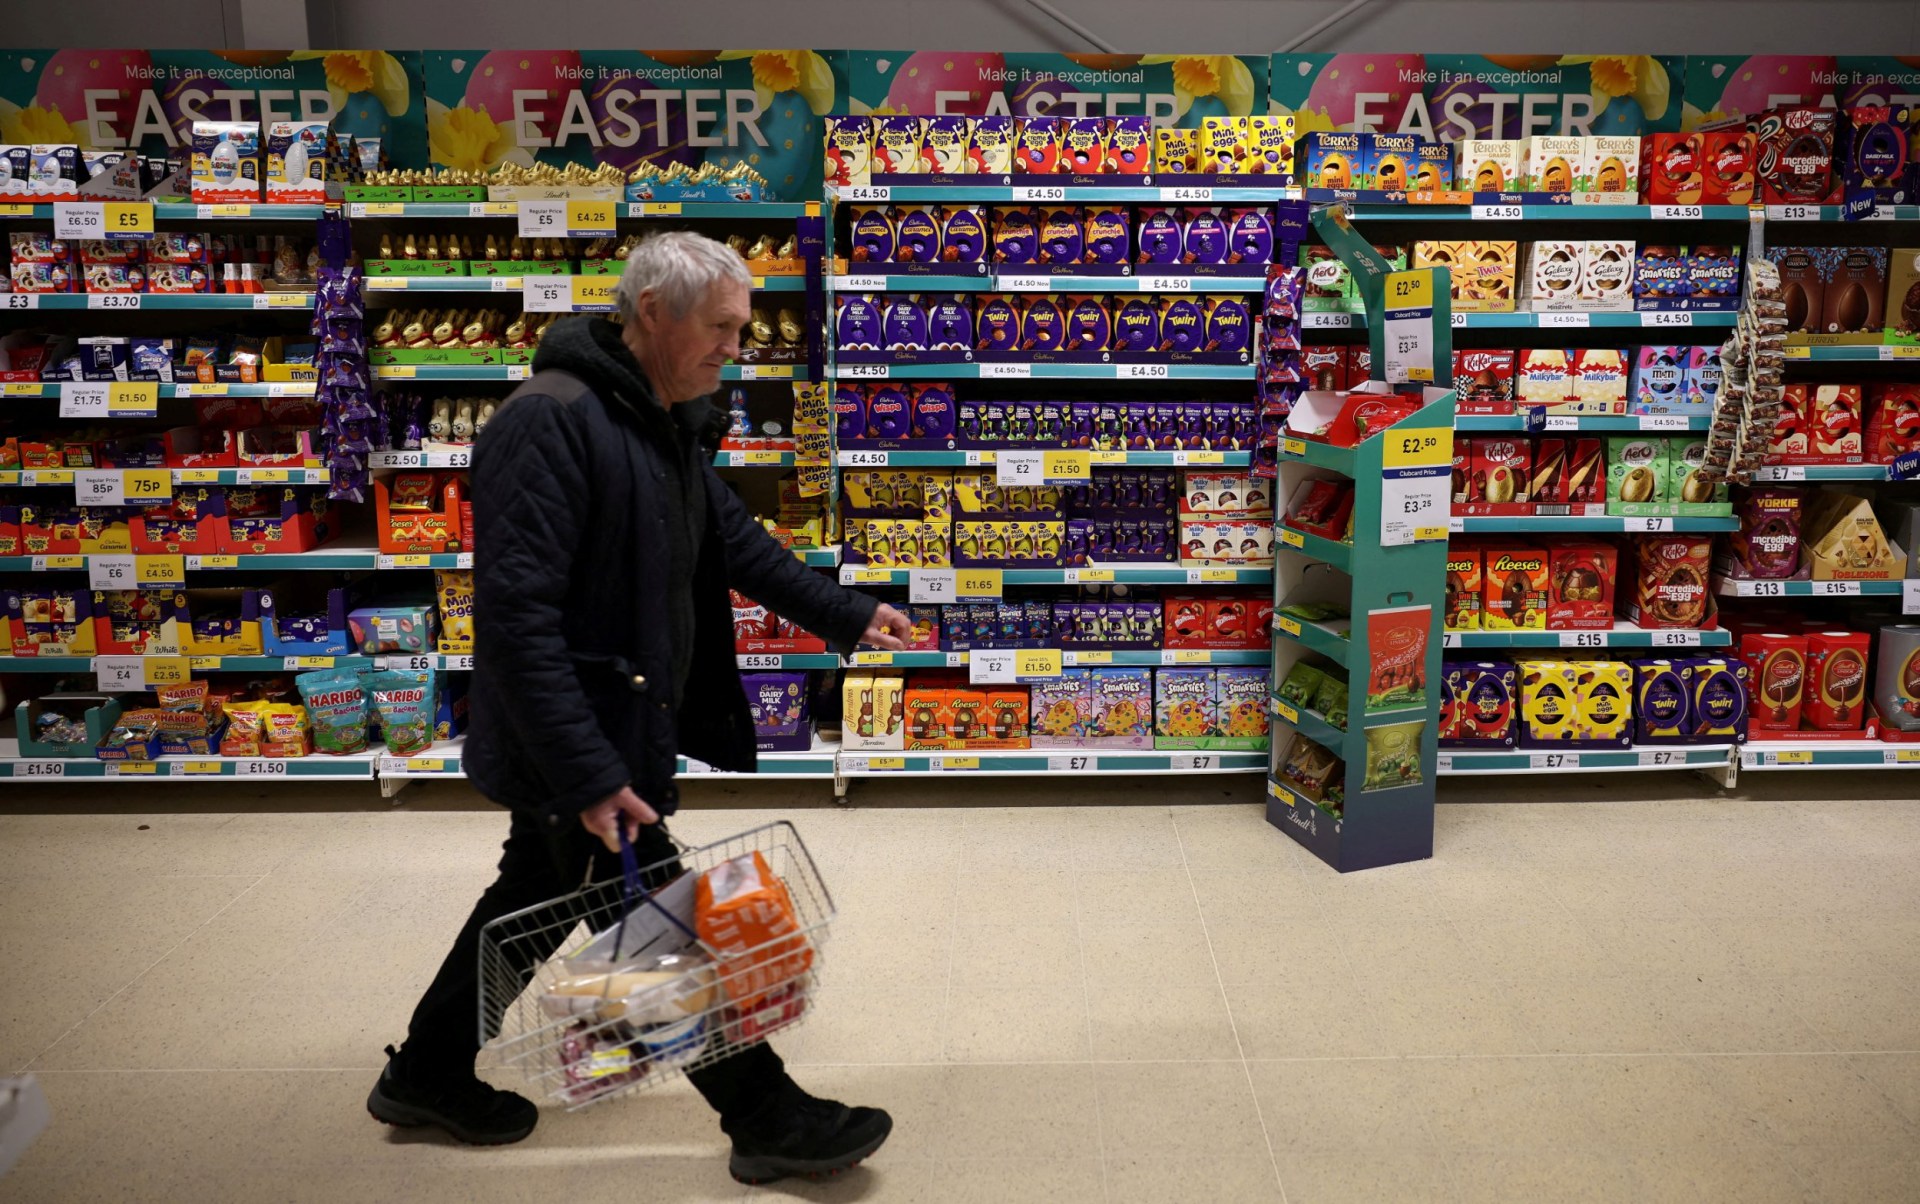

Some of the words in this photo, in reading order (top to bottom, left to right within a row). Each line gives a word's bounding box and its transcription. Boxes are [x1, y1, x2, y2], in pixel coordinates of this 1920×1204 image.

[126, 65, 164, 79] Make
[170, 66, 179, 78] it
[185, 69, 203, 79] an
[208, 65, 294, 83] exceptional
[555, 65, 594, 79] Make
[599, 66, 608, 78] it
[613, 69, 631, 79] an
[636, 65, 722, 83] exceptional
[979, 67, 1017, 81] Make
[1022, 68, 1031, 81] it
[1036, 72, 1054, 82] an
[1058, 69, 1143, 87] exceptional
[1399, 69, 1438, 83] Make
[1441, 69, 1450, 83] it
[1455, 73, 1473, 83] an
[1477, 69, 1561, 86] exceptional
[1811, 70, 1848, 85] Make
[1852, 71, 1864, 84] it
[1867, 74, 1884, 84] an
[84, 89, 331, 147] EASTER
[512, 88, 769, 148] EASTER
[1788, 111, 1813, 128] KitKat
[1212, 128, 1235, 139] Mini
[1259, 126, 1281, 139] Mini
[836, 135, 854, 143] creme
[1213, 136, 1237, 147] eggs
[1260, 135, 1284, 147] eggs
[1165, 141, 1186, 151] Mini
[1167, 147, 1188, 158] eggs
[1782, 155, 1829, 167] Incredible
[853, 189, 888, 198] £4.50
[1027, 188, 1063, 199] £4.50
[1175, 189, 1210, 199] £4.50
[1666, 206, 1700, 217] £4.50
[1850, 198, 1872, 214] New
[577, 213, 605, 222] £4.25
[1486, 207, 1521, 217] £4.50
[1784, 207, 1805, 218] £13
[69, 217, 97, 226] £6.50
[120, 213, 138, 226] £5
[539, 215, 553, 225] £5
[1544, 265, 1575, 277] Galaxy
[1593, 265, 1625, 277] Galaxy
[1154, 280, 1188, 290] £4.50
[1396, 280, 1420, 296] £2.50
[544, 290, 558, 300] £5
[582, 288, 610, 297] £4.25
[9, 296, 28, 308] £3
[103, 297, 138, 307] £3.70
[1030, 312, 1055, 322] Twirl
[1168, 315, 1197, 326] Twirl
[1315, 316, 1349, 326] £4.50
[1655, 313, 1690, 324] £4.50
[852, 366, 886, 376] £4.50
[1132, 366, 1165, 376] £4.50
[1530, 373, 1563, 382] Milkybar
[1583, 373, 1617, 382] Milkybar
[74, 396, 102, 405] £1.75
[119, 393, 147, 402] £1.50
[802, 399, 826, 410] Mini
[874, 403, 901, 413] Wispa
[919, 403, 946, 413] Wispa
[1529, 410, 1545, 426] New
[1403, 437, 1437, 454] £2.50
[1488, 443, 1516, 461] KitKat
[384, 455, 419, 466] £2.50
[852, 454, 886, 464] £4.50
[1016, 464, 1029, 474] £2
[1053, 465, 1080, 474] £1.50
[1896, 456, 1918, 474] New
[1403, 500, 1432, 513] £3.25
[1757, 498, 1799, 508] YORKIE
[1646, 518, 1663, 531] £7
[1752, 534, 1797, 545] Incredible
[1662, 544, 1688, 560] KitKat
[1494, 552, 1542, 571] Reese's
[109, 569, 123, 578] £6
[146, 569, 174, 578] £4.50
[1832, 569, 1889, 580] TOBLERONE
[929, 582, 942, 591] £2
[966, 580, 992, 589] £1.65
[1659, 584, 1704, 595] Incredible
[1754, 583, 1779, 594] £13
[1577, 634, 1601, 646] £15
[410, 657, 429, 669] £6
[746, 656, 780, 667] £5.50
[989, 662, 1002, 672] £2
[1025, 663, 1052, 672] £1.50
[117, 670, 131, 680] £4
[154, 671, 181, 680] £2.95
[166, 687, 203, 699] HARIBO
[310, 689, 362, 706] HARIBO
[375, 689, 423, 703] HARIBO
[759, 691, 785, 699] DAIRY
[762, 697, 781, 705] MILK
[910, 698, 939, 709] Reese's
[951, 698, 980, 709] Reese's
[993, 698, 1022, 709] Reese's
[1652, 699, 1677, 710] Twirl
[843, 688, 855, 727] Thorntons
[874, 687, 885, 728] Thorntons
[160, 714, 198, 724] HARIBO
[948, 740, 966, 750] WIN
[99, 751, 127, 760] HARIBO
[27, 763, 62, 774] £1.50
[250, 763, 284, 773] £1.50
[1070, 757, 1087, 770] £7
[1193, 757, 1210, 769] £7
[1287, 808, 1311, 836] Lindt
